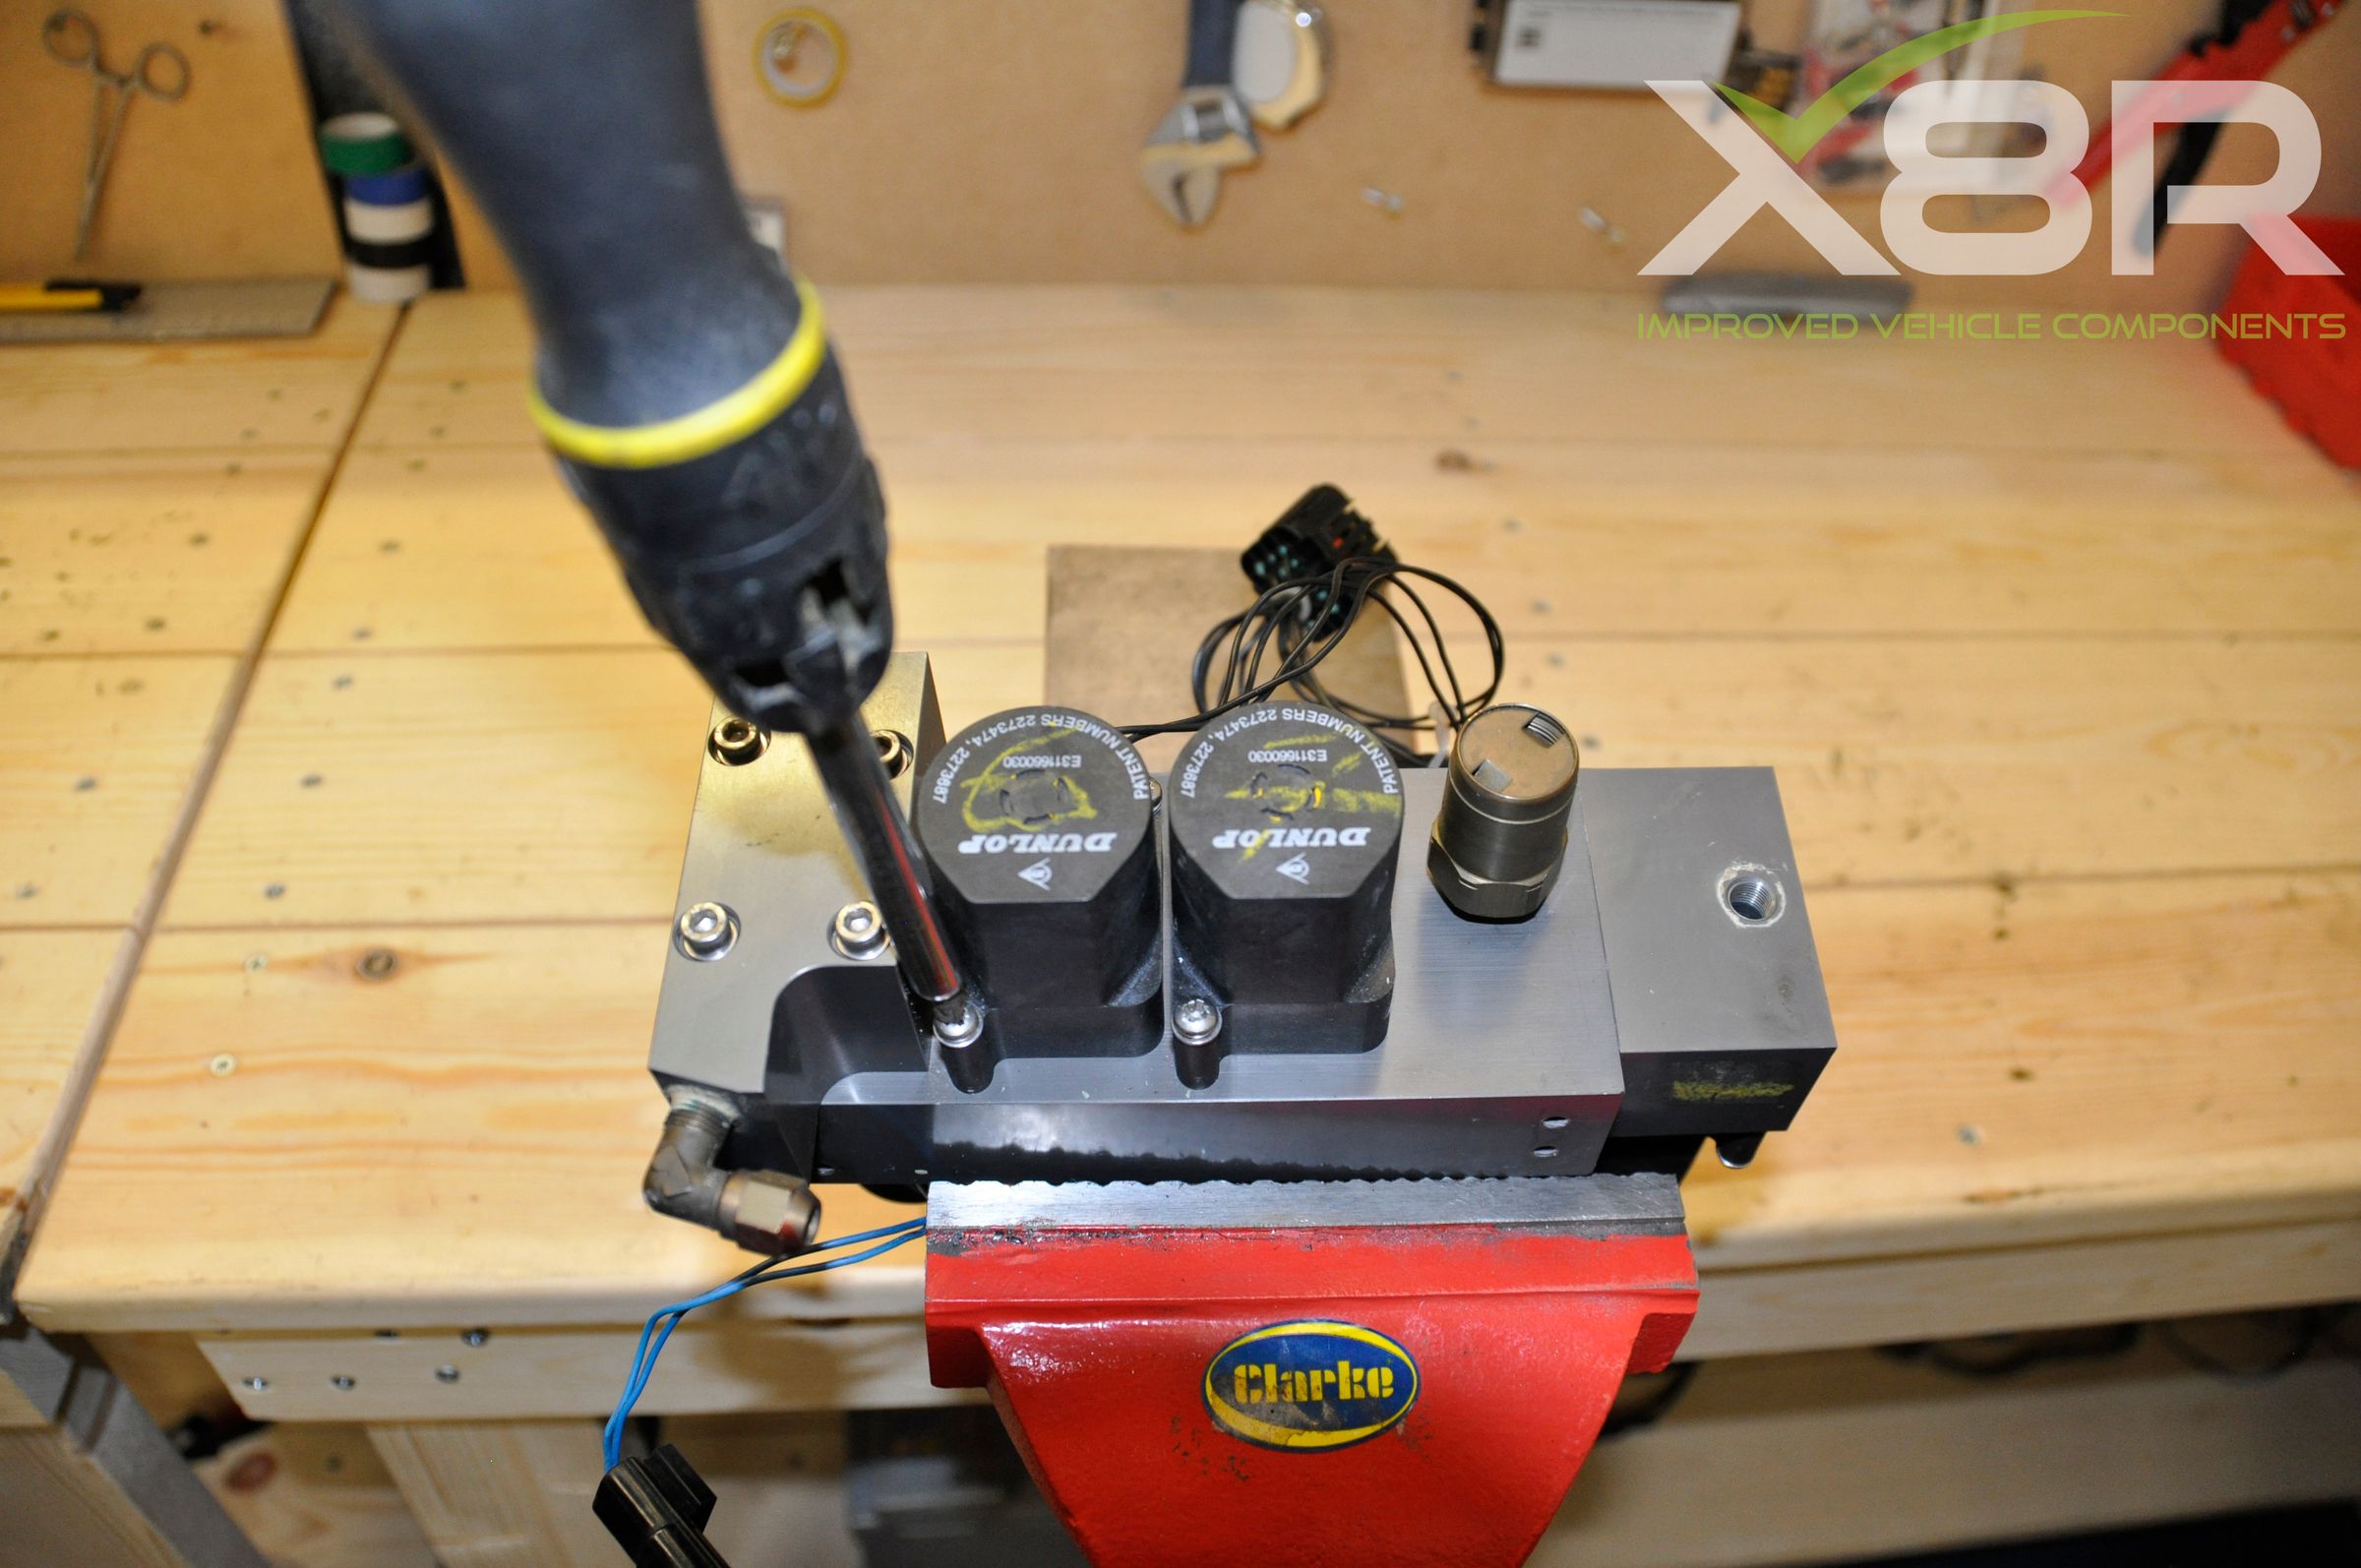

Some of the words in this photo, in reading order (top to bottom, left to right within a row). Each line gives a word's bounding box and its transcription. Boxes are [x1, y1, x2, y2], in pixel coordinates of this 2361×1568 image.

[1041, 713, 1121, 750] NUMBERS
[1282, 708, 1364, 744] NUMBERS
[1115, 748, 1149, 800] PATENT
[1361, 744, 1398, 795] PATENT
[958, 832, 1118, 854] DUNLOP
[1212, 827, 1371, 849] DUNLOP
[1234, 1360, 1394, 1405] Clarke
